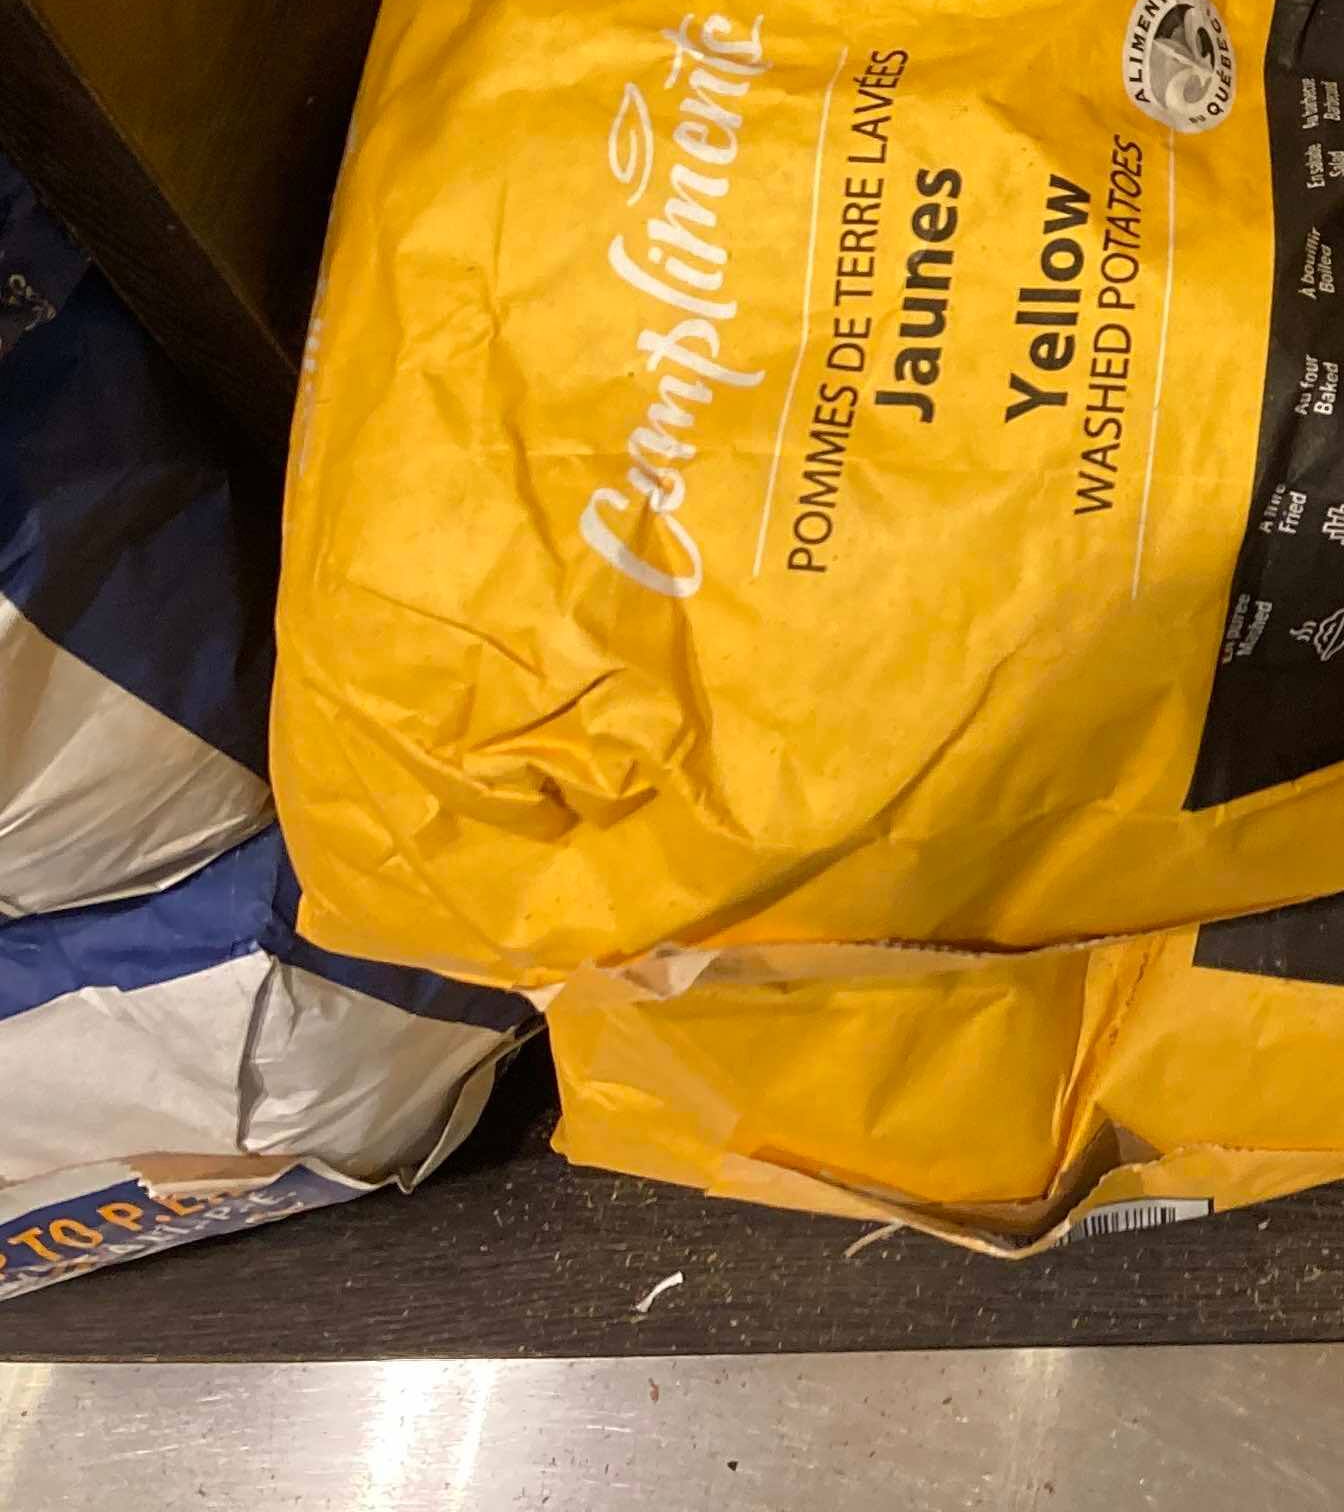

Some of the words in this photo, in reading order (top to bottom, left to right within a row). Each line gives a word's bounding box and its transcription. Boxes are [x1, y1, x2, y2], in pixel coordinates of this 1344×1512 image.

[846, 49, 910, 165] LAVÉES
[833, 176, 884, 306] TERRE
[1096, 134, 1143, 311] POTATOES
[578, 13, 773, 596] Compliments
[826, 317, 874, 373] DE
[873, 166, 964, 424] Jaunes
[1003, 173, 1092, 425] Yellow
[1072, 323, 1132, 516] WASHED
[1300, 353, 1321, 390] four
[1313, 361, 1340, 416] Baked
[787, 383, 859, 573] POMMES
[1278, 489, 1308, 535] Fried
[7, 1217, 104, 1263] TO
